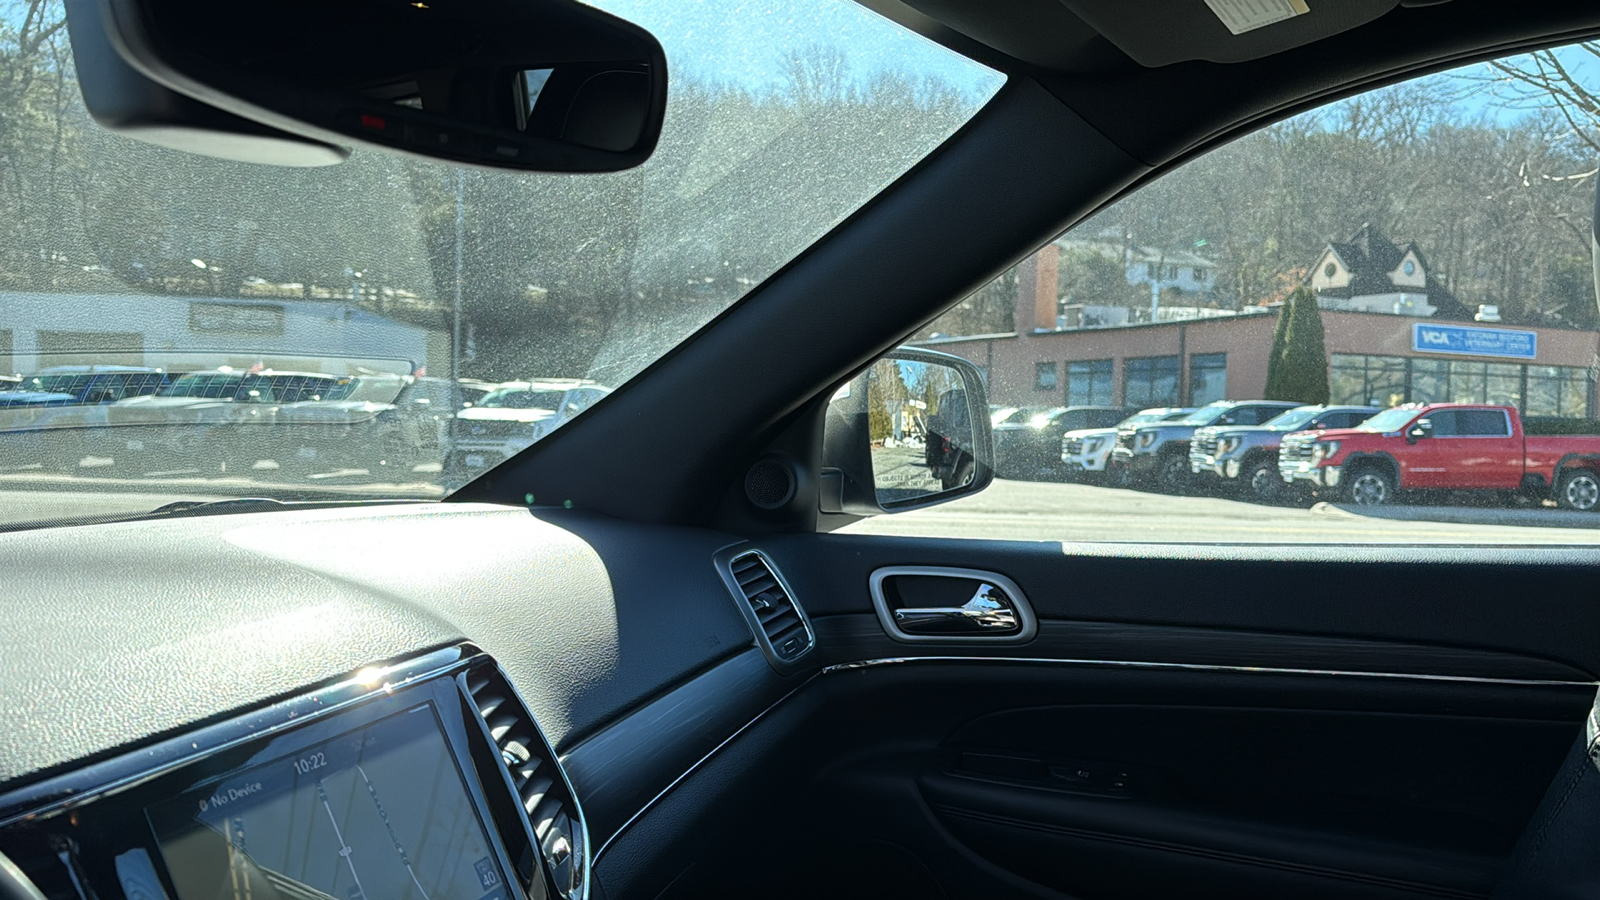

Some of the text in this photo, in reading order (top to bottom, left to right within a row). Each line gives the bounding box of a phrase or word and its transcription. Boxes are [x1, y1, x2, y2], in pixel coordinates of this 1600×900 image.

[1422, 330, 1450, 345] VCA
[882, 474, 904, 482] OBJECTS
[293, 751, 328, 776] 10:22
[210, 782, 263, 808] No Device
[483, 870, 496, 887] 40
